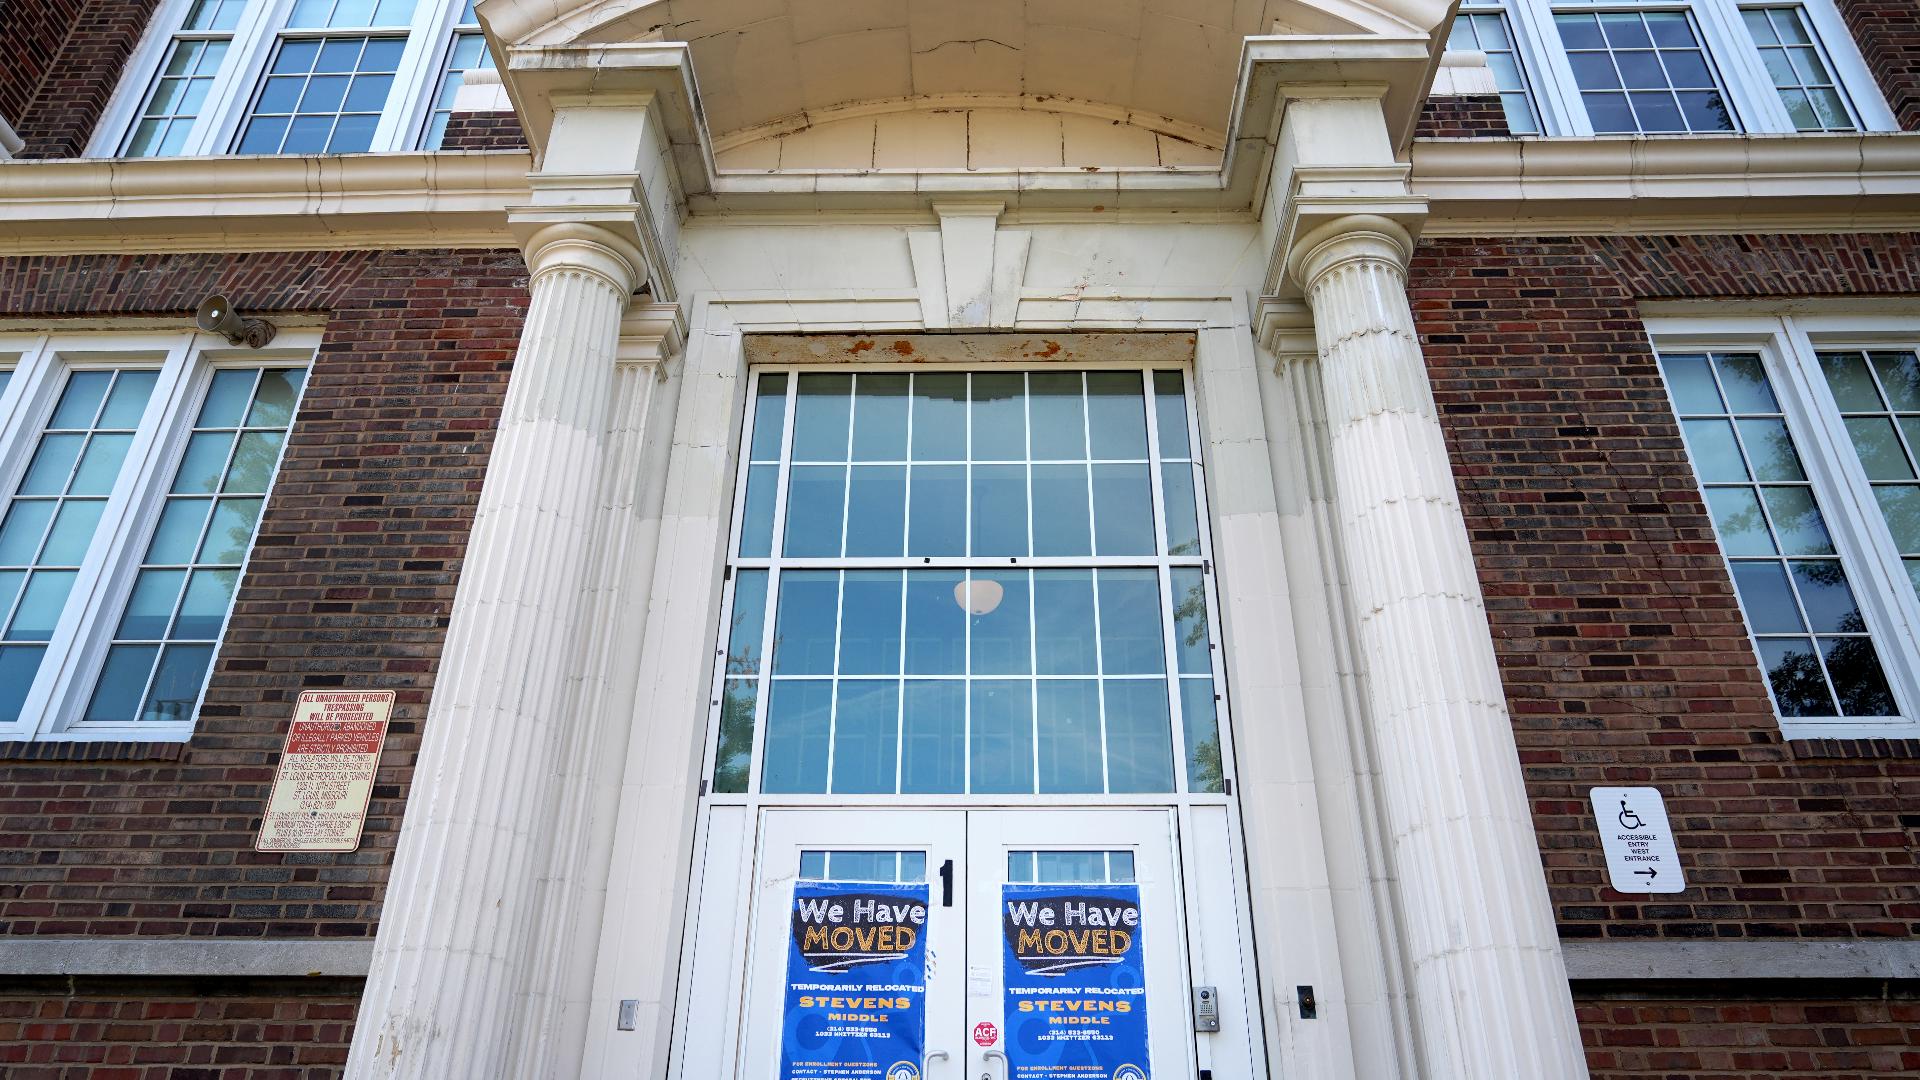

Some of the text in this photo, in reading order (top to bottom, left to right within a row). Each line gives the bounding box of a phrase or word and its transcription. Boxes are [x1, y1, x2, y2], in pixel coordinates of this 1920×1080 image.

[303, 693, 390, 703] ALL UNAUTHORIZED PERSONS
[323, 703, 365, 712] TRESPASSING
[309, 712, 374, 721] WILL BE PROSECUTED
[342, 721, 377, 731] ABANDONED
[291, 732, 380, 743] OR ILLEGALLY PARKED VEHICLES
[308, 743, 335, 753] STRICTLY
[335, 743, 369, 753] PROHIBITED
[300, 754, 329, 763] VIOLATORS
[329, 754, 342, 763] WILL
[351, 754, 371, 763] TOWED
[289, 771, 306, 781] LOUIS
[348, 771, 371, 781] TOWING
[940, 860, 953, 907] 1
[798, 898, 926, 925] We Have
[1007, 901, 1139, 927] We Have
[803, 925, 916, 951] MOVED
[1017, 928, 1132, 954] MOVED
[791, 983, 925, 993] TEMPORARILY RELOCATED
[1009, 987, 1145, 995] TEMPORARILY RELOCATED
[799, 995, 911, 1009] STEVENS
[1018, 1000, 1132, 1012] STEVENS
[827, 1012, 889, 1022] MIDDLE
[1049, 1016, 1111, 1025] MIDDLE
[975, 1027, 997, 1037] ACF
